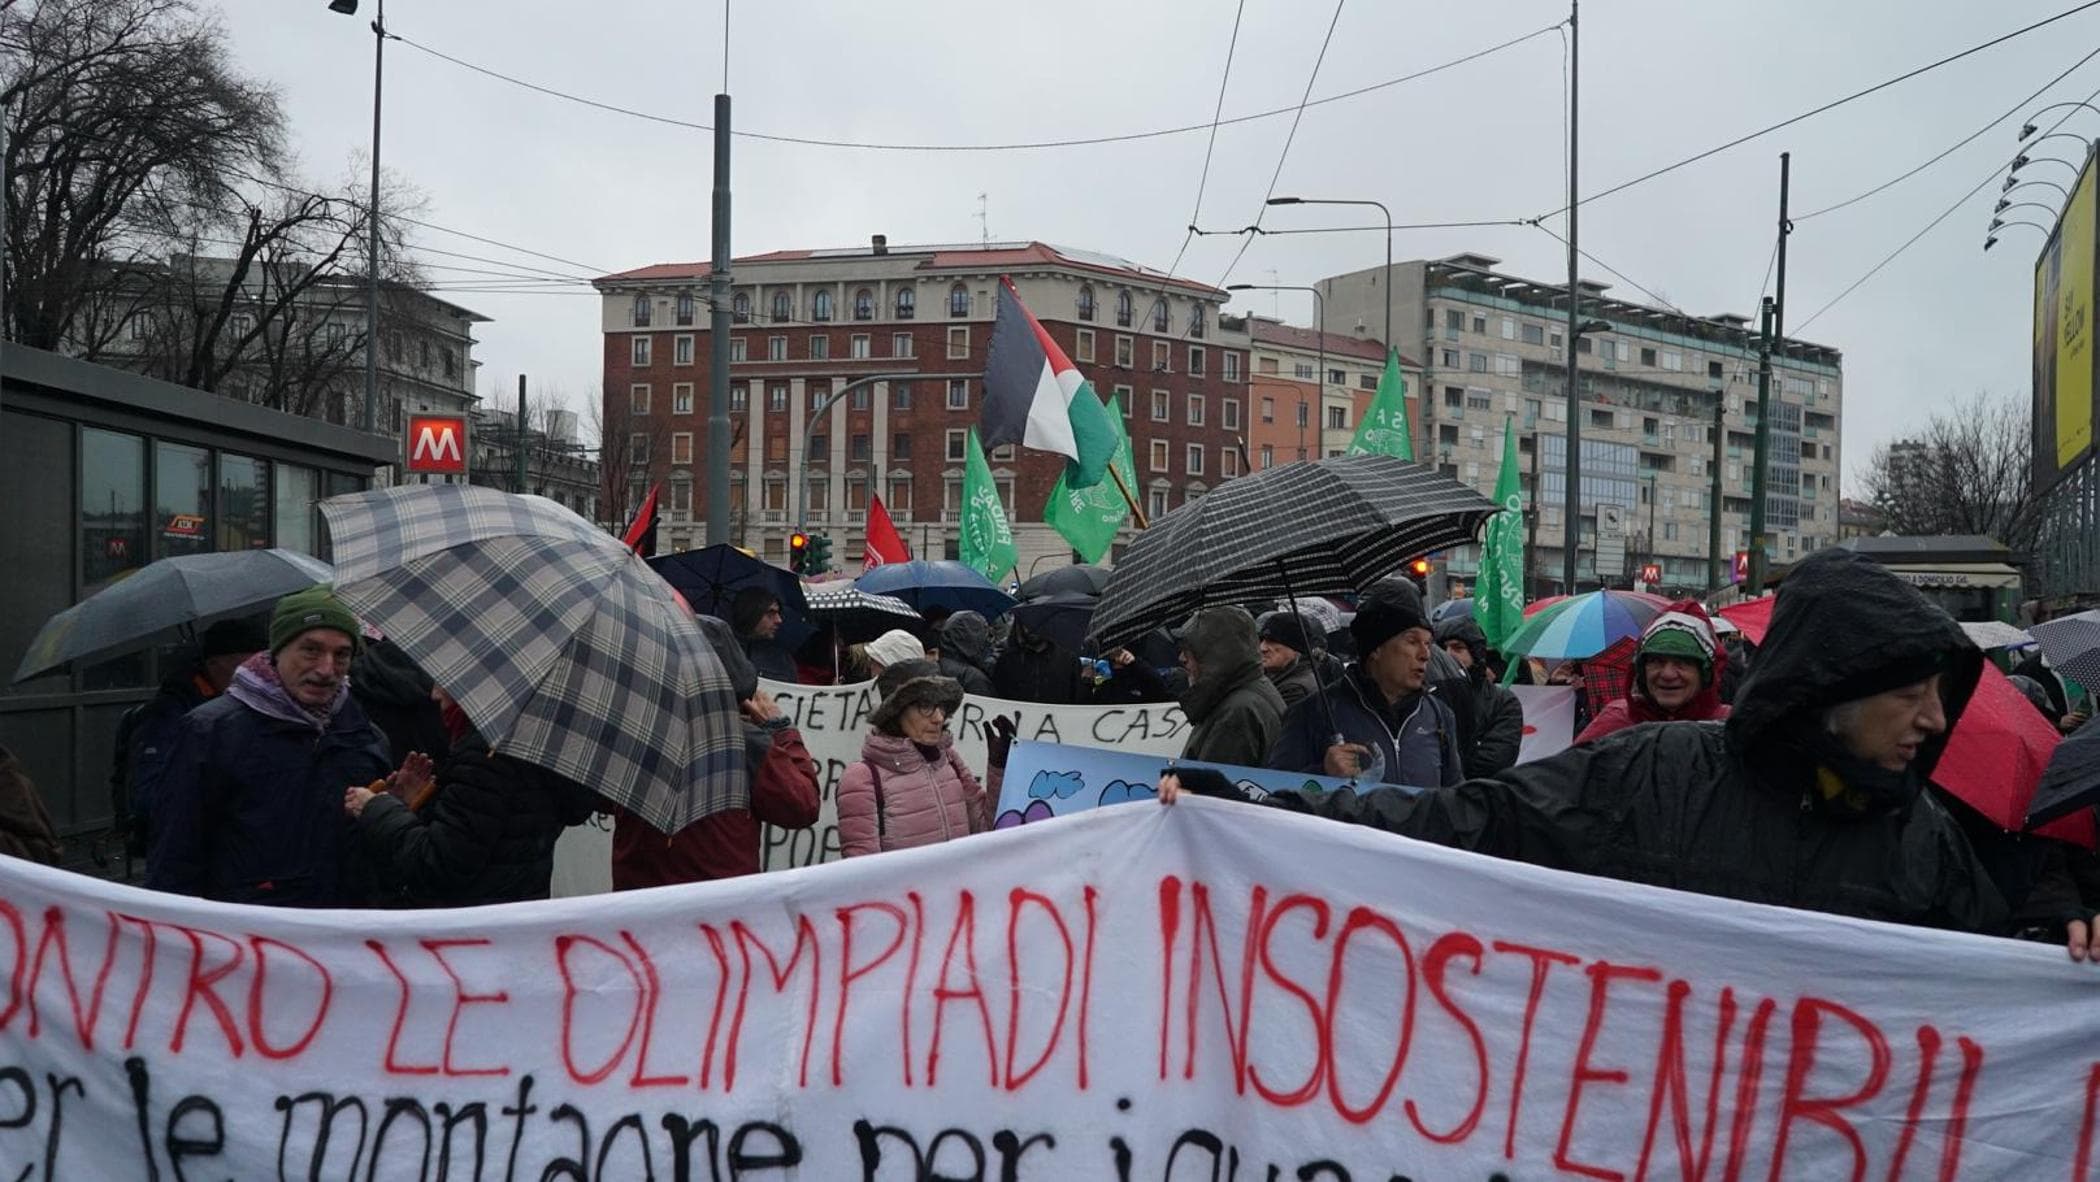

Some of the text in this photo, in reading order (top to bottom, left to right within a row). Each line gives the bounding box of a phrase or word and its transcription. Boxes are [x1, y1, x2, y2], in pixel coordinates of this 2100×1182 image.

[413, 427, 461, 461] M
[1643, 566, 1659, 580] M
[1092, 706, 1192, 743] CAS
[366, 938, 511, 1078] LE
[553, 884, 1098, 1093] OLIMPIADI
[123, 1056, 234, 1182] le
